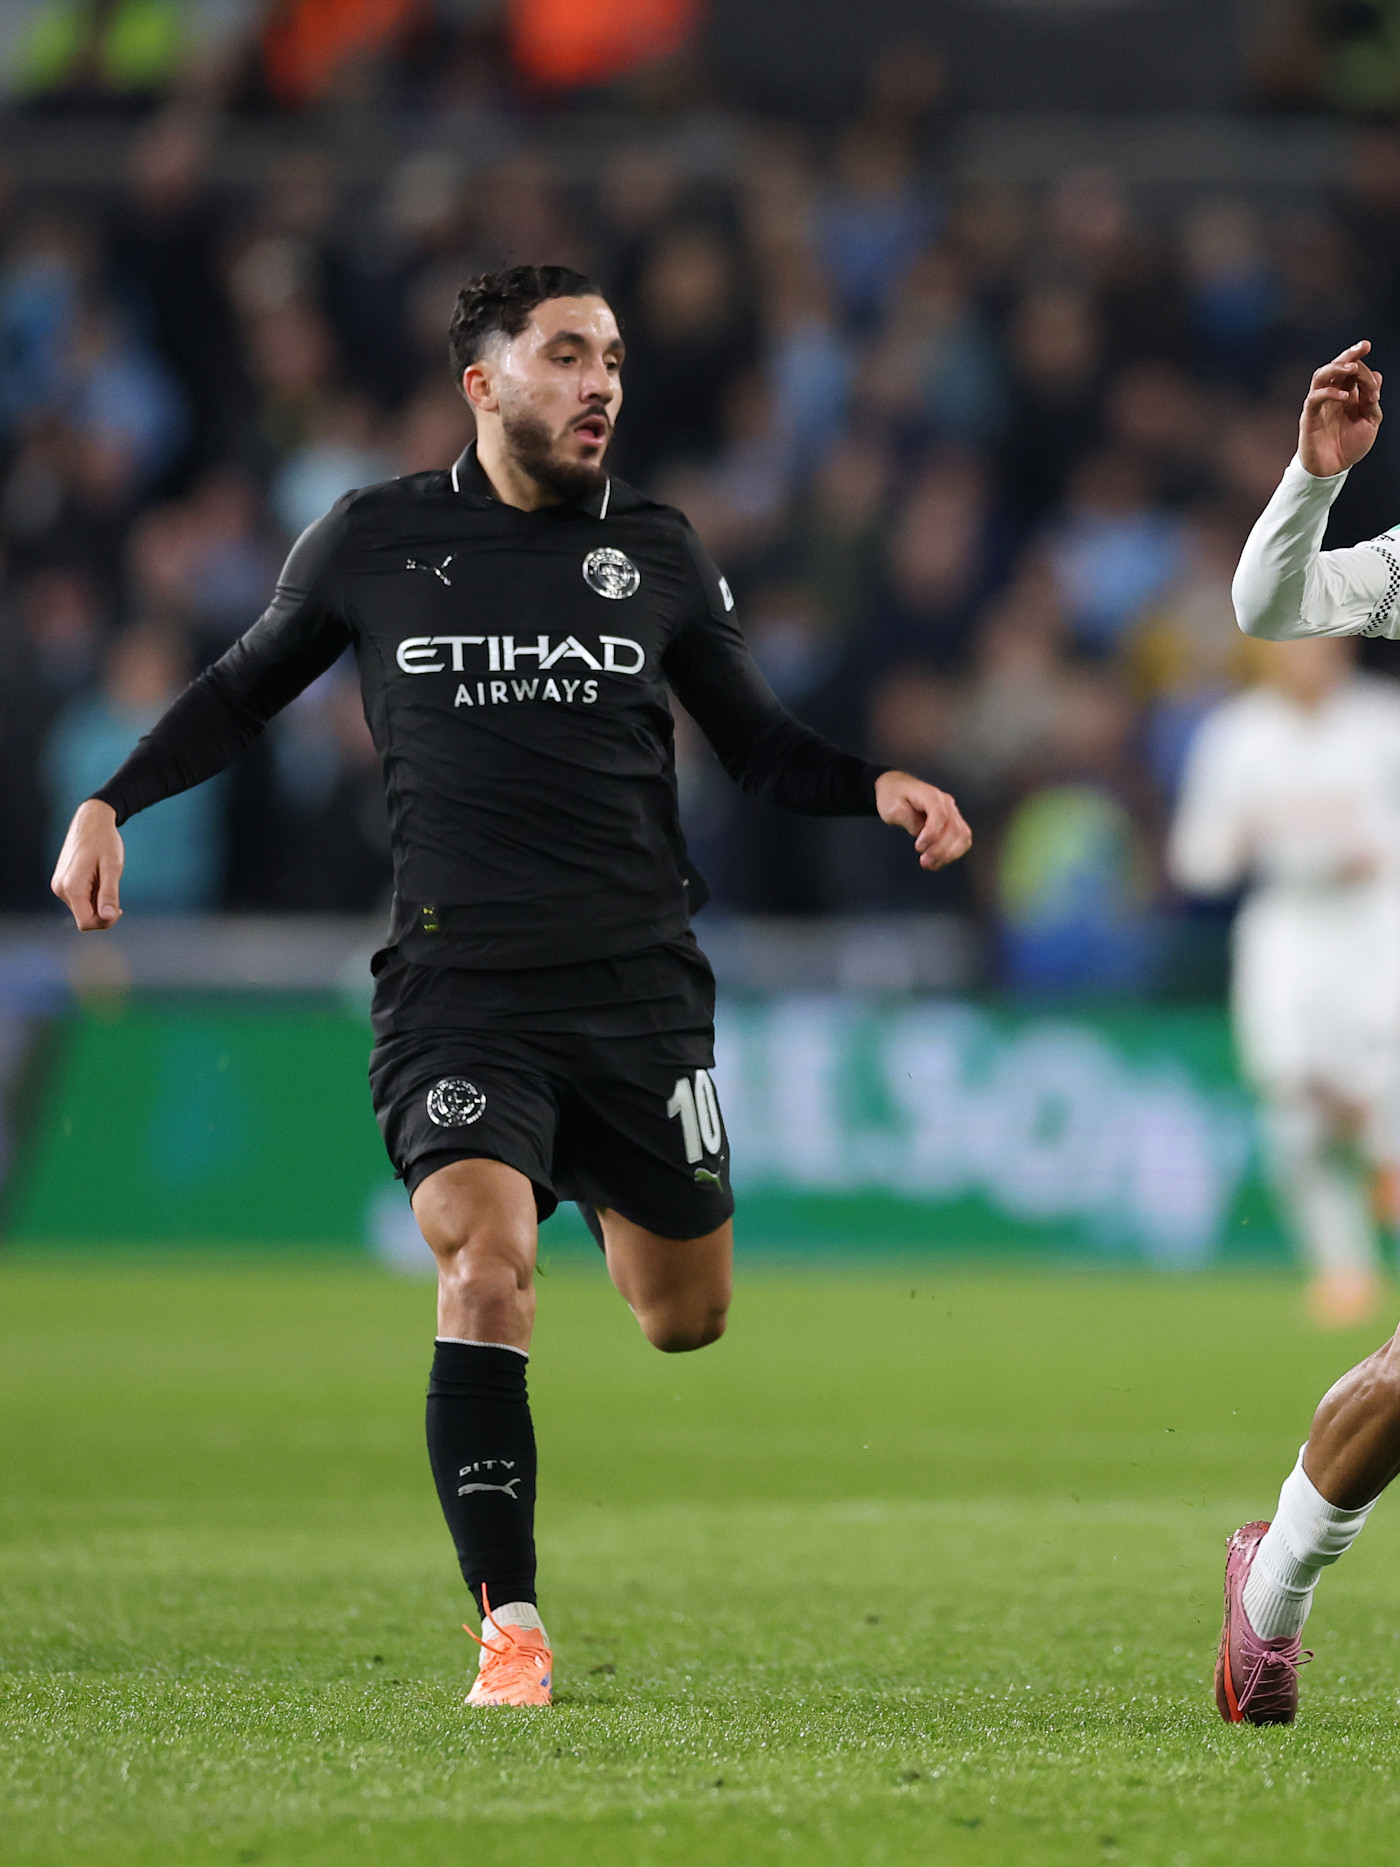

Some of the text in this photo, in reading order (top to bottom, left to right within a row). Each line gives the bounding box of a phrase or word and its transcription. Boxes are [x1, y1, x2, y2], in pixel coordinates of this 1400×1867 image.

[396, 635, 646, 675] ETIHAD
[453, 678, 599, 708] AIRWAYS
[667, 1068, 722, 1165] 10
